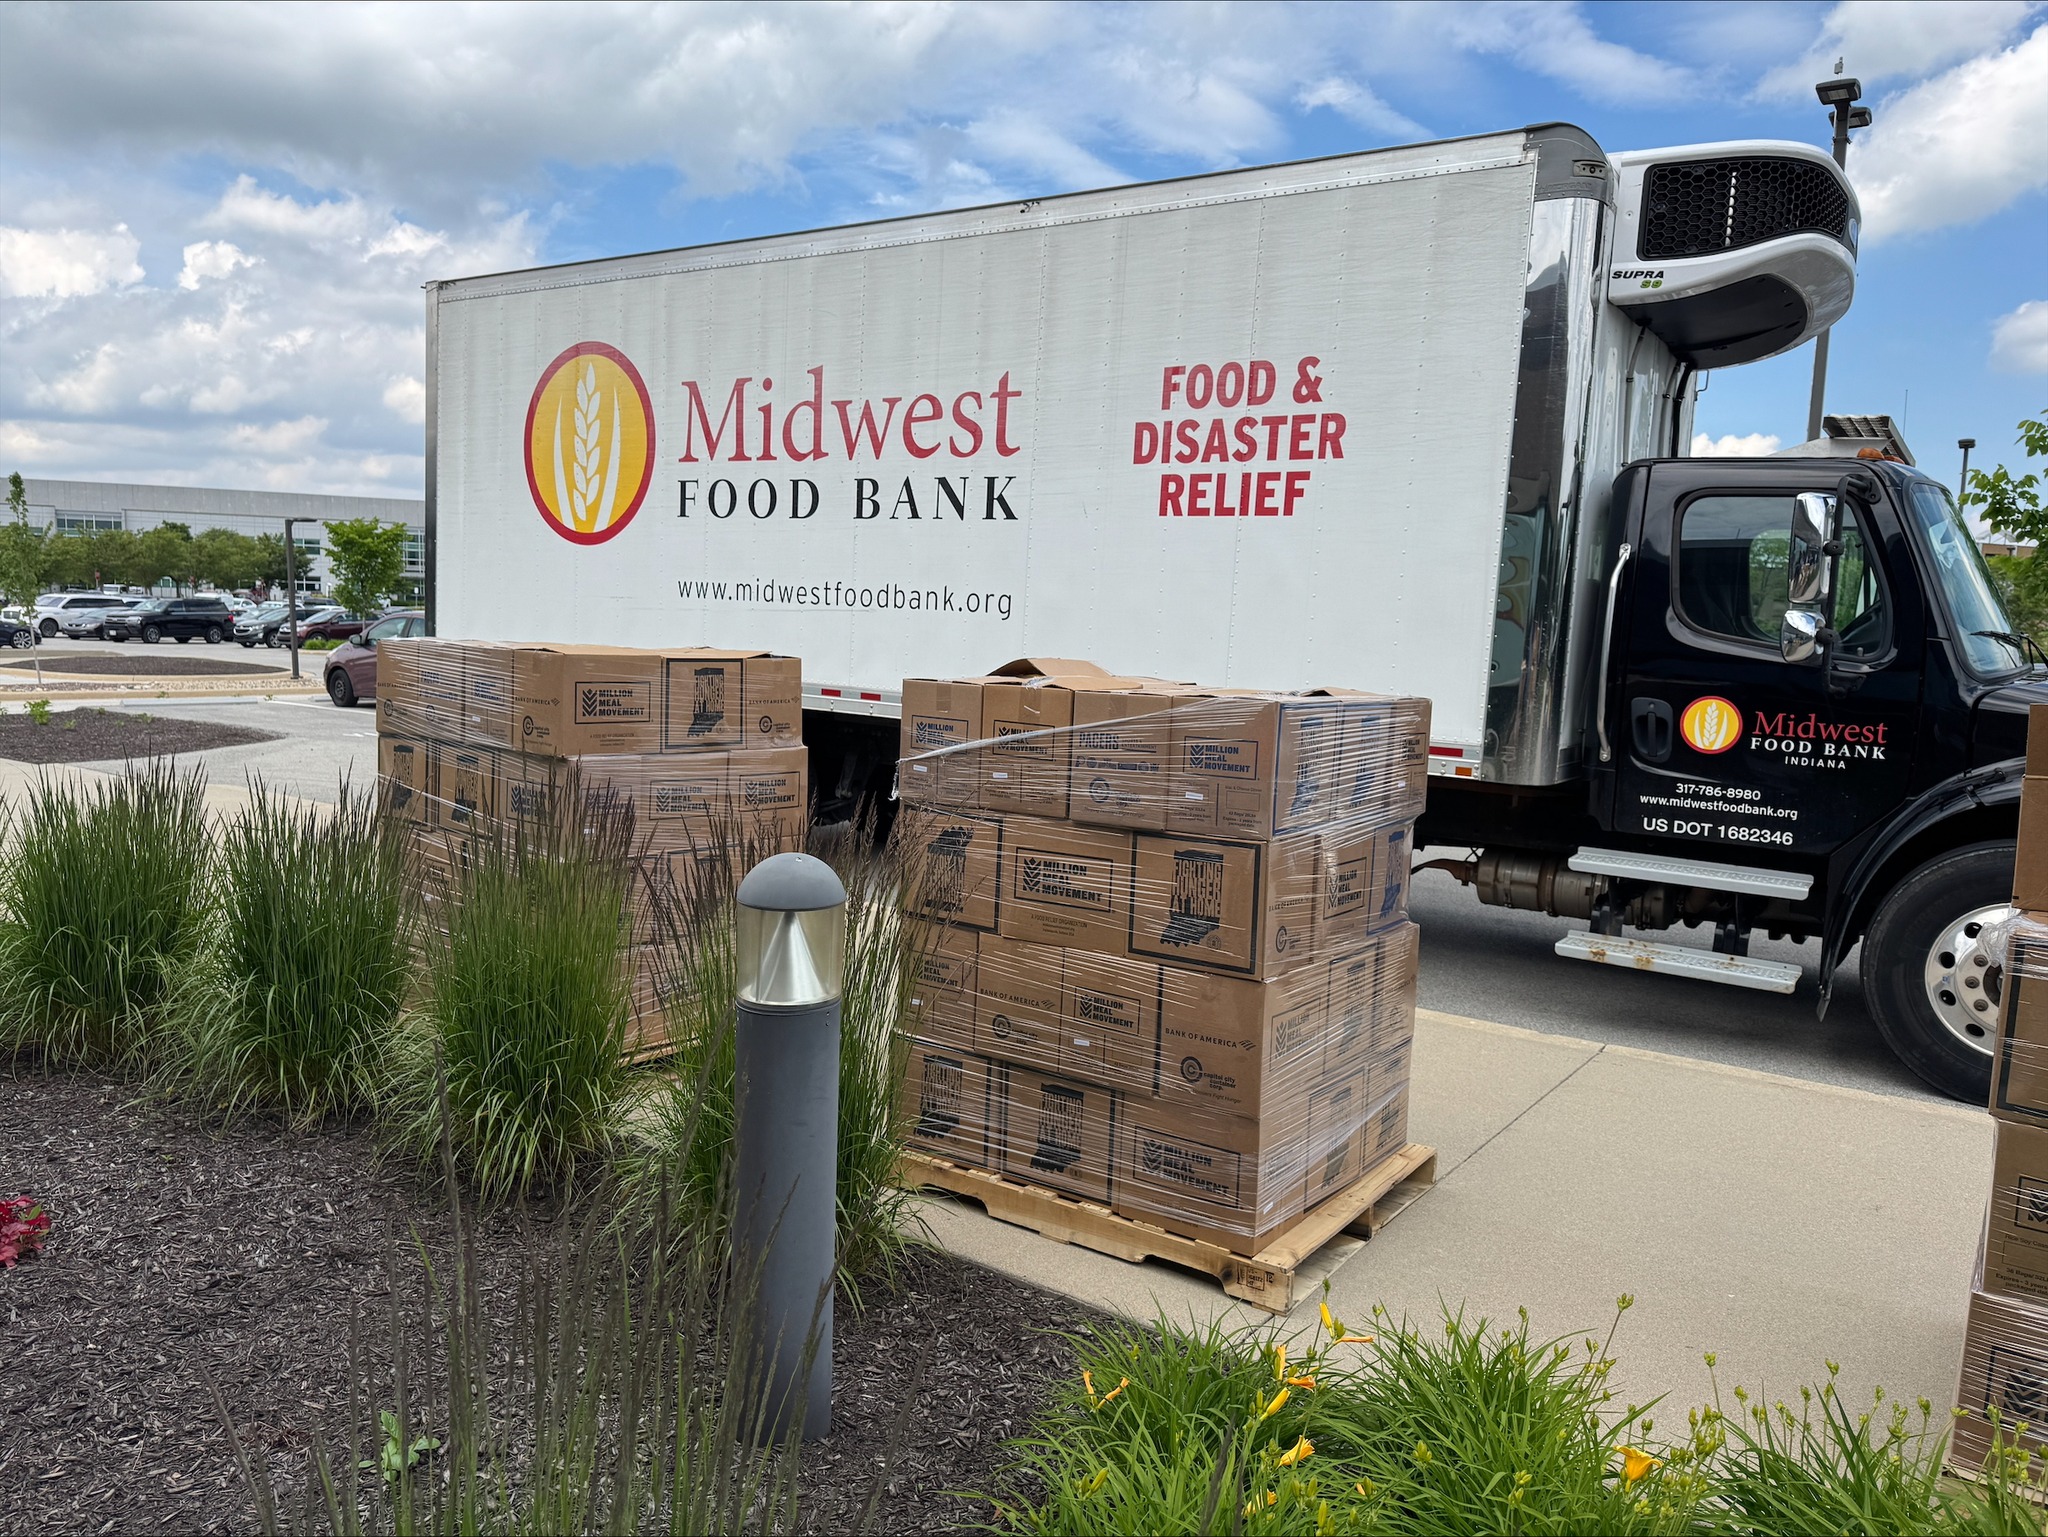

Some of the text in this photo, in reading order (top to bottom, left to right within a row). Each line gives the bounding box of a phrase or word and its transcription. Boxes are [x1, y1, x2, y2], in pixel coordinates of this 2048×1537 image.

[1611, 270, 1664, 279] SUPRA
[1161, 356, 1323, 411] FOOD &
[678, 365, 1022, 463] Midwest
[1133, 412, 1347, 465] DISASTER
[677, 475, 1019, 520] FOOD BANK
[1158, 471, 1311, 517] RELIEF
[677, 578, 1013, 621] www.midwestfoodbank.org
[598, 688, 633, 698] MILLION
[598, 699, 622, 707] MEAL
[598, 707, 645, 717] MOVEMENT
[927, 722, 954, 732] MILLION
[1752, 711, 1888, 744] Midwest
[1205, 744, 1239, 755] MILLION
[1750, 737, 1886, 760] FOOD BANK
[1205, 753, 1227, 762] MEAL
[1785, 756, 1847, 770] INDIANA
[1204, 762, 1251, 773] MOVEMENT
[671, 786, 703, 795] MILLION
[759, 779, 787, 788] MILLION
[671, 795, 692, 803] MEAL
[758, 788, 778, 796] MEAL
[1675, 783, 1761, 801] 317-786-8980
[757, 795, 796, 805] MOVEMENT
[1640, 794, 1799, 821] www.midwestfoodbank.org
[1643, 817, 1794, 846] US DOT 1682346
[1042, 860, 1087, 876] MILLION
[1174, 859, 1222, 879] FIGHTING
[1042, 872, 1072, 886] MEAL
[1041, 884, 1103, 902] MOVEMENT
[1171, 874, 1221, 901] HUNGER
[1172, 894, 1221, 919] AT HOME
[924, 960, 949, 970] MILLION
[924, 967, 941, 976] MEAL
[923, 973, 958, 987] MOVEMENT
[981, 988, 1040, 1008] BANK OF AMERICA
[1093, 996, 1123, 1010] MILLION
[1093, 1004, 1113, 1016] MEAL
[1092, 1012, 1134, 1028] MOVEMENT
[1165, 1027, 1238, 1048] BANK OF AMERICA
[1203, 1072, 1236, 1084] capitol city
[1163, 1144, 1212, 1167] MILLION
[1163, 1157, 1195, 1174] MEAL
[1163, 1168, 1230, 1195] MOVEMENT
[1995, 1273, 2019, 1283] Expires
